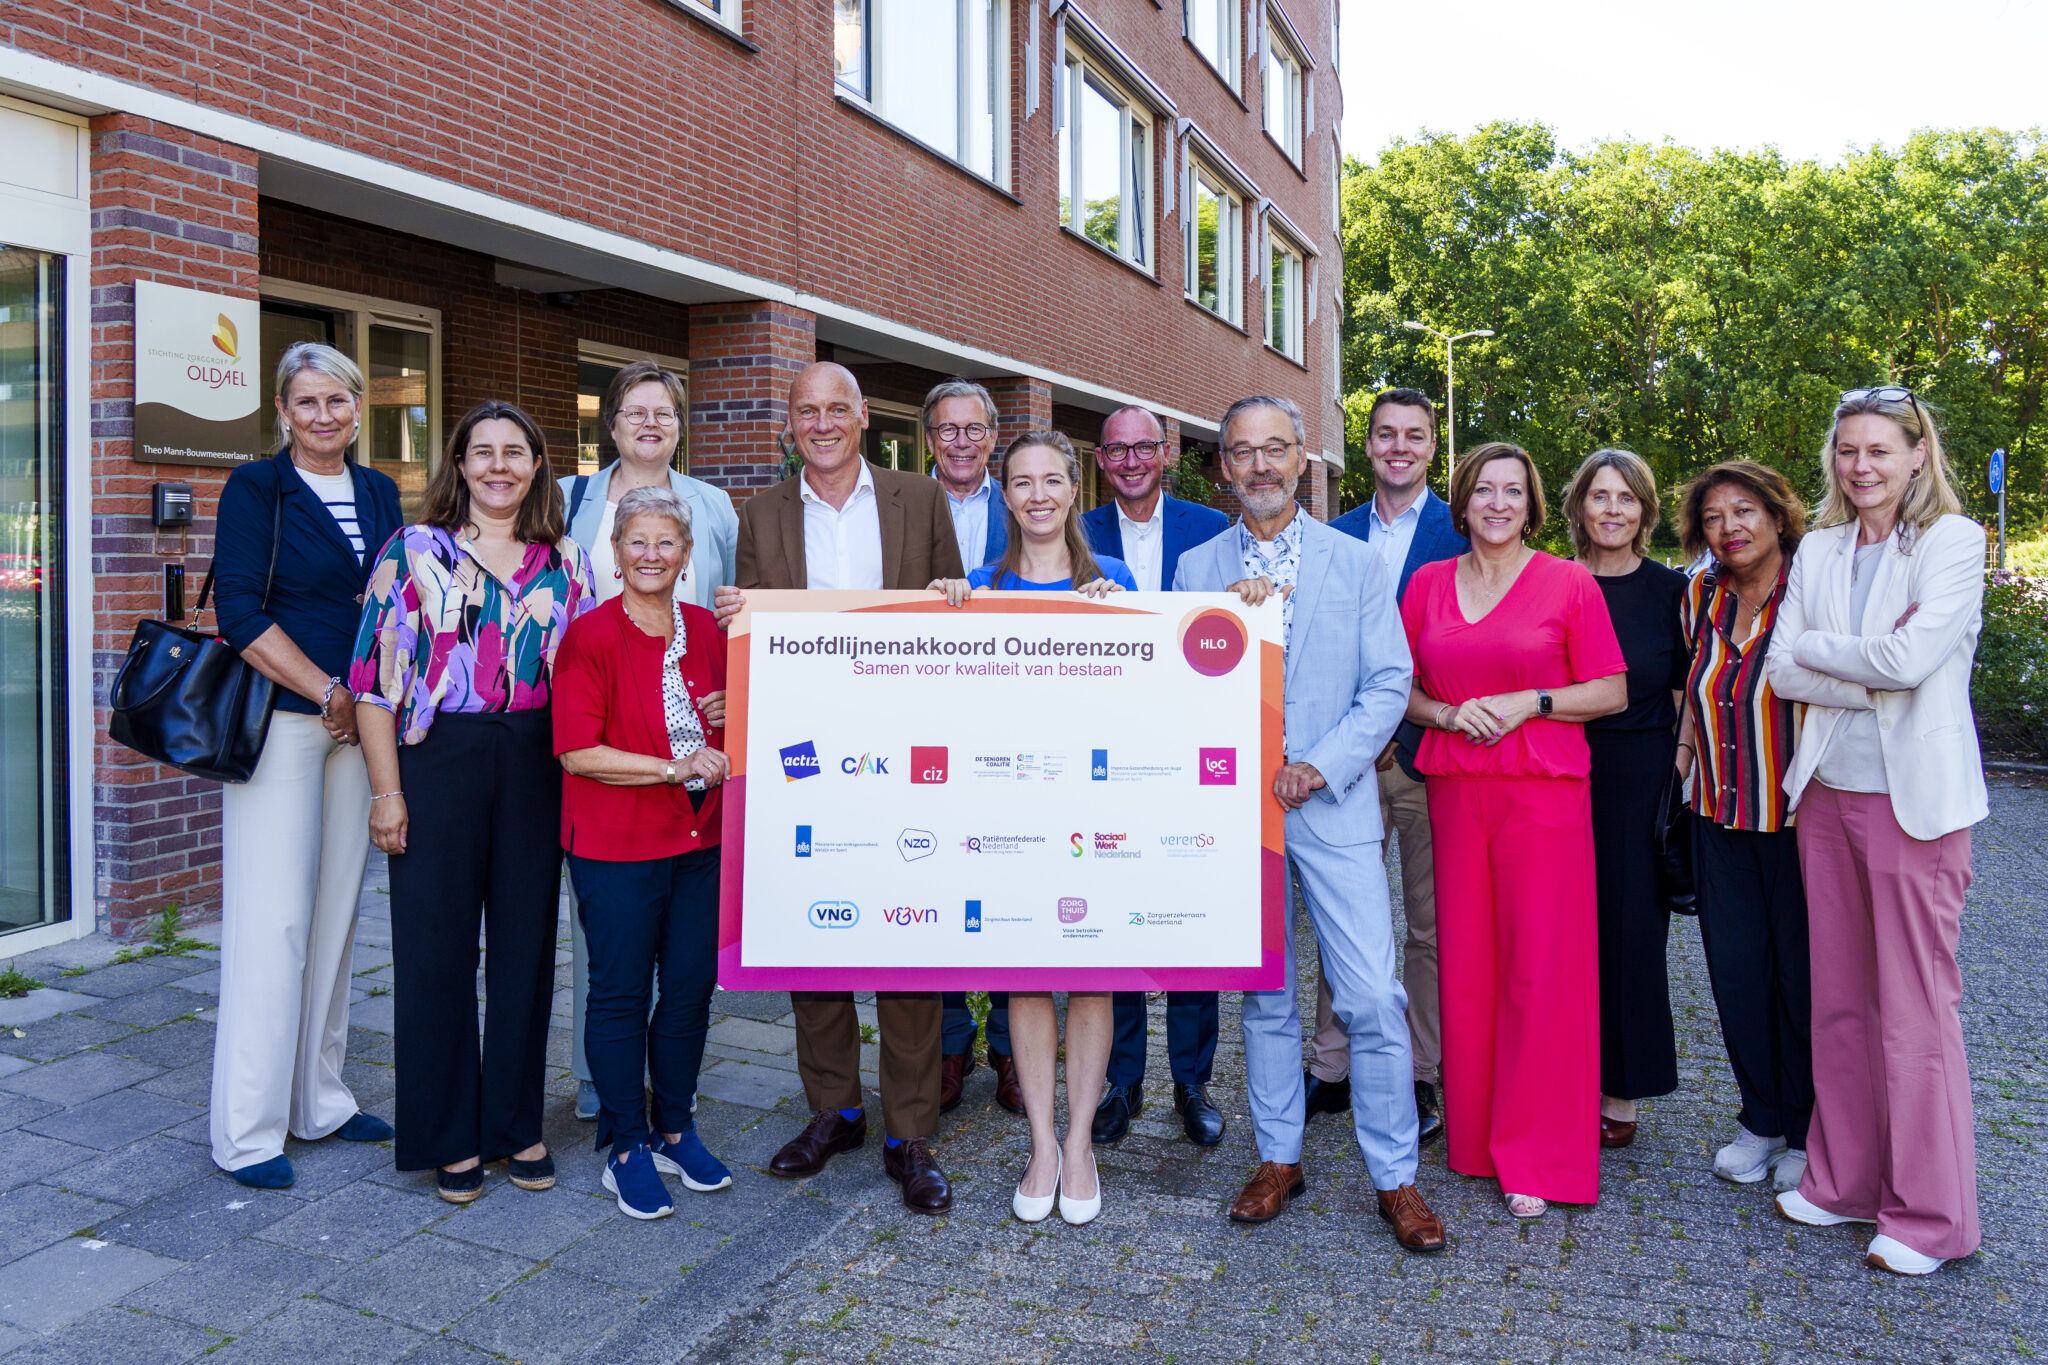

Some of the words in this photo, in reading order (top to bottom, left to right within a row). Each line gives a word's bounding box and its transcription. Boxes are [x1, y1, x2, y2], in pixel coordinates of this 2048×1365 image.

[148, 348, 184, 360] STICHTING
[187, 353, 228, 365] ZORGGROEP
[187, 365, 247, 389] OLDAEL
[143, 444, 162, 455] Theo
[164, 446, 248, 461] Mann-Bouwmeesterlaan
[249, 453, 254, 461] 1
[768, 635, 996, 660] Hoofdlijnenakkoord
[1004, 636, 1155, 662] Ouderenzorg
[1200, 638, 1227, 650] HLO
[853, 660, 910, 676] Samen
[915, 663, 951, 676] voor
[955, 660, 1020, 676] kwaliteit
[1024, 664, 1054, 677] van
[1059, 661, 1122, 677] bestaan
[923, 766, 943, 781] ciz
[983, 835, 1046, 843] Patiëntenfederatie
[1094, 832, 1126, 841] Sociaal
[1094, 841, 1118, 850] Werk
[1094, 850, 1141, 859] Nederland
[816, 909, 852, 921] VNG
